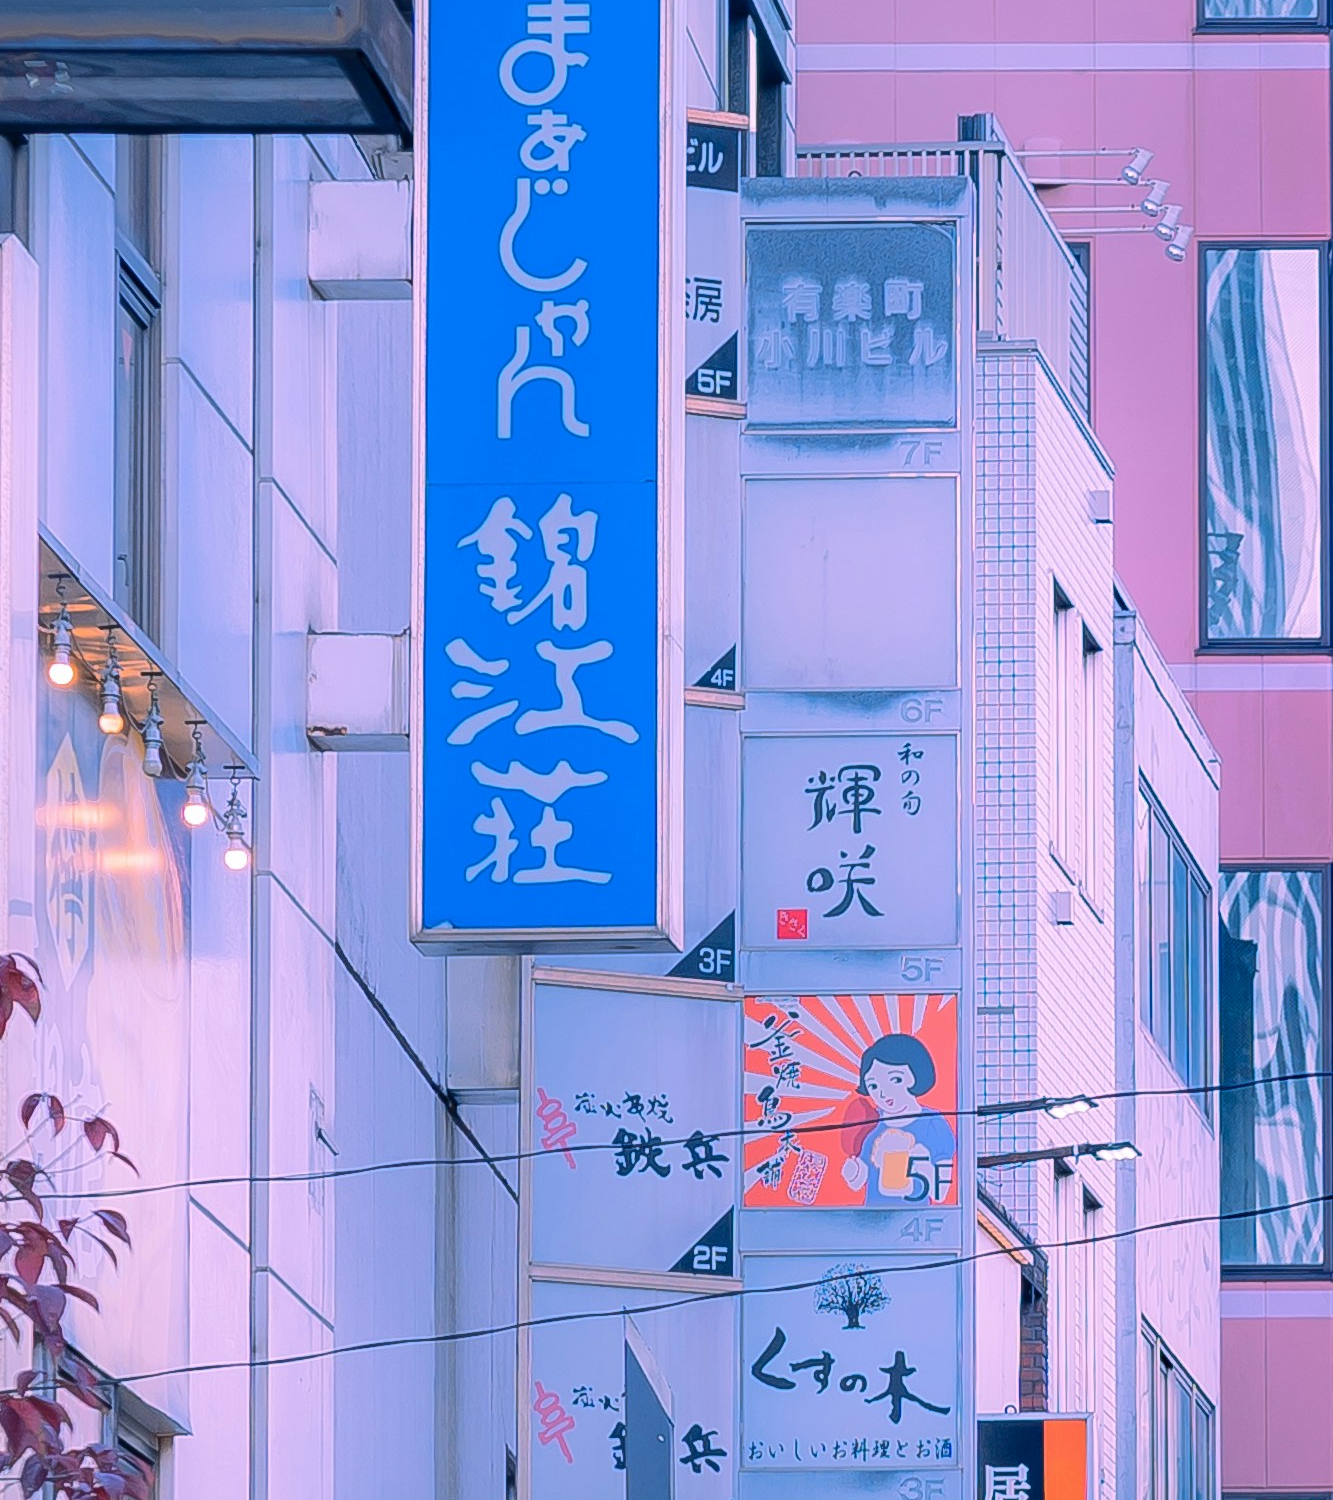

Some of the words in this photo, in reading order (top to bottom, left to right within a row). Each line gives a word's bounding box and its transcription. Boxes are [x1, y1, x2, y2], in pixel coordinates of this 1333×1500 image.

[782, 280, 923, 323] 有楽町
[757, 327, 948, 368] 小川ビル
[698, 369, 732, 395] 5F
[900, 440, 943, 466] 7F
[444, 493, 640, 886] 錦江荘
[709, 667, 734, 689] 4F
[901, 699, 943, 723] 6F
[699, 948, 731, 973] 3F
[901, 956, 943, 981] 5F
[903, 1155, 954, 1202] 5F
[900, 1219, 944, 1242] 4F
[693, 1246, 728, 1271] 2F
[751, 1327, 950, 1424] くすの木
[748, 1437, 951, 1464] おいしいお料理とお酒
